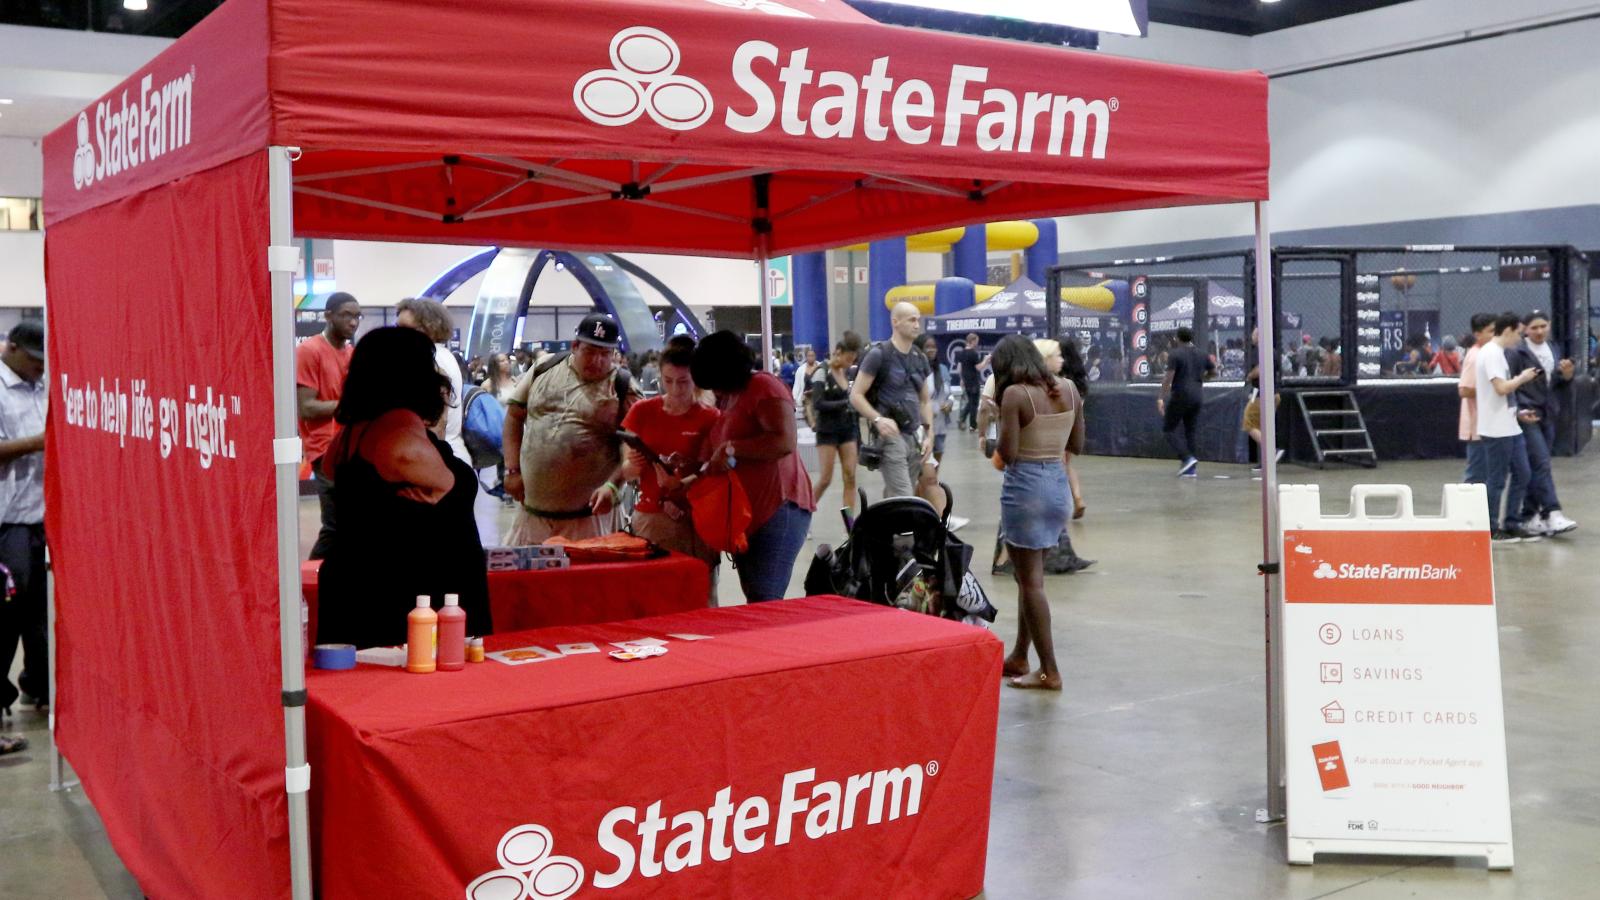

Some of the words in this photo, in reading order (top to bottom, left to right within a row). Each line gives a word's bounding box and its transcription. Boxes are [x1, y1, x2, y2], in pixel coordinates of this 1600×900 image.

[86, 381, 98, 429] to
[100, 376, 127, 448] help
[131, 379, 154, 441] life
[159, 397, 179, 459] go
[1352, 628, 1405, 641] LOANS
[1353, 667, 1424, 681] SAVINGS
[1354, 710, 1414, 724] CREDIT
[1423, 711, 1478, 725] CARDS
[1380, 756, 1402, 766] about
[1417, 757, 1443, 767] Pocket
